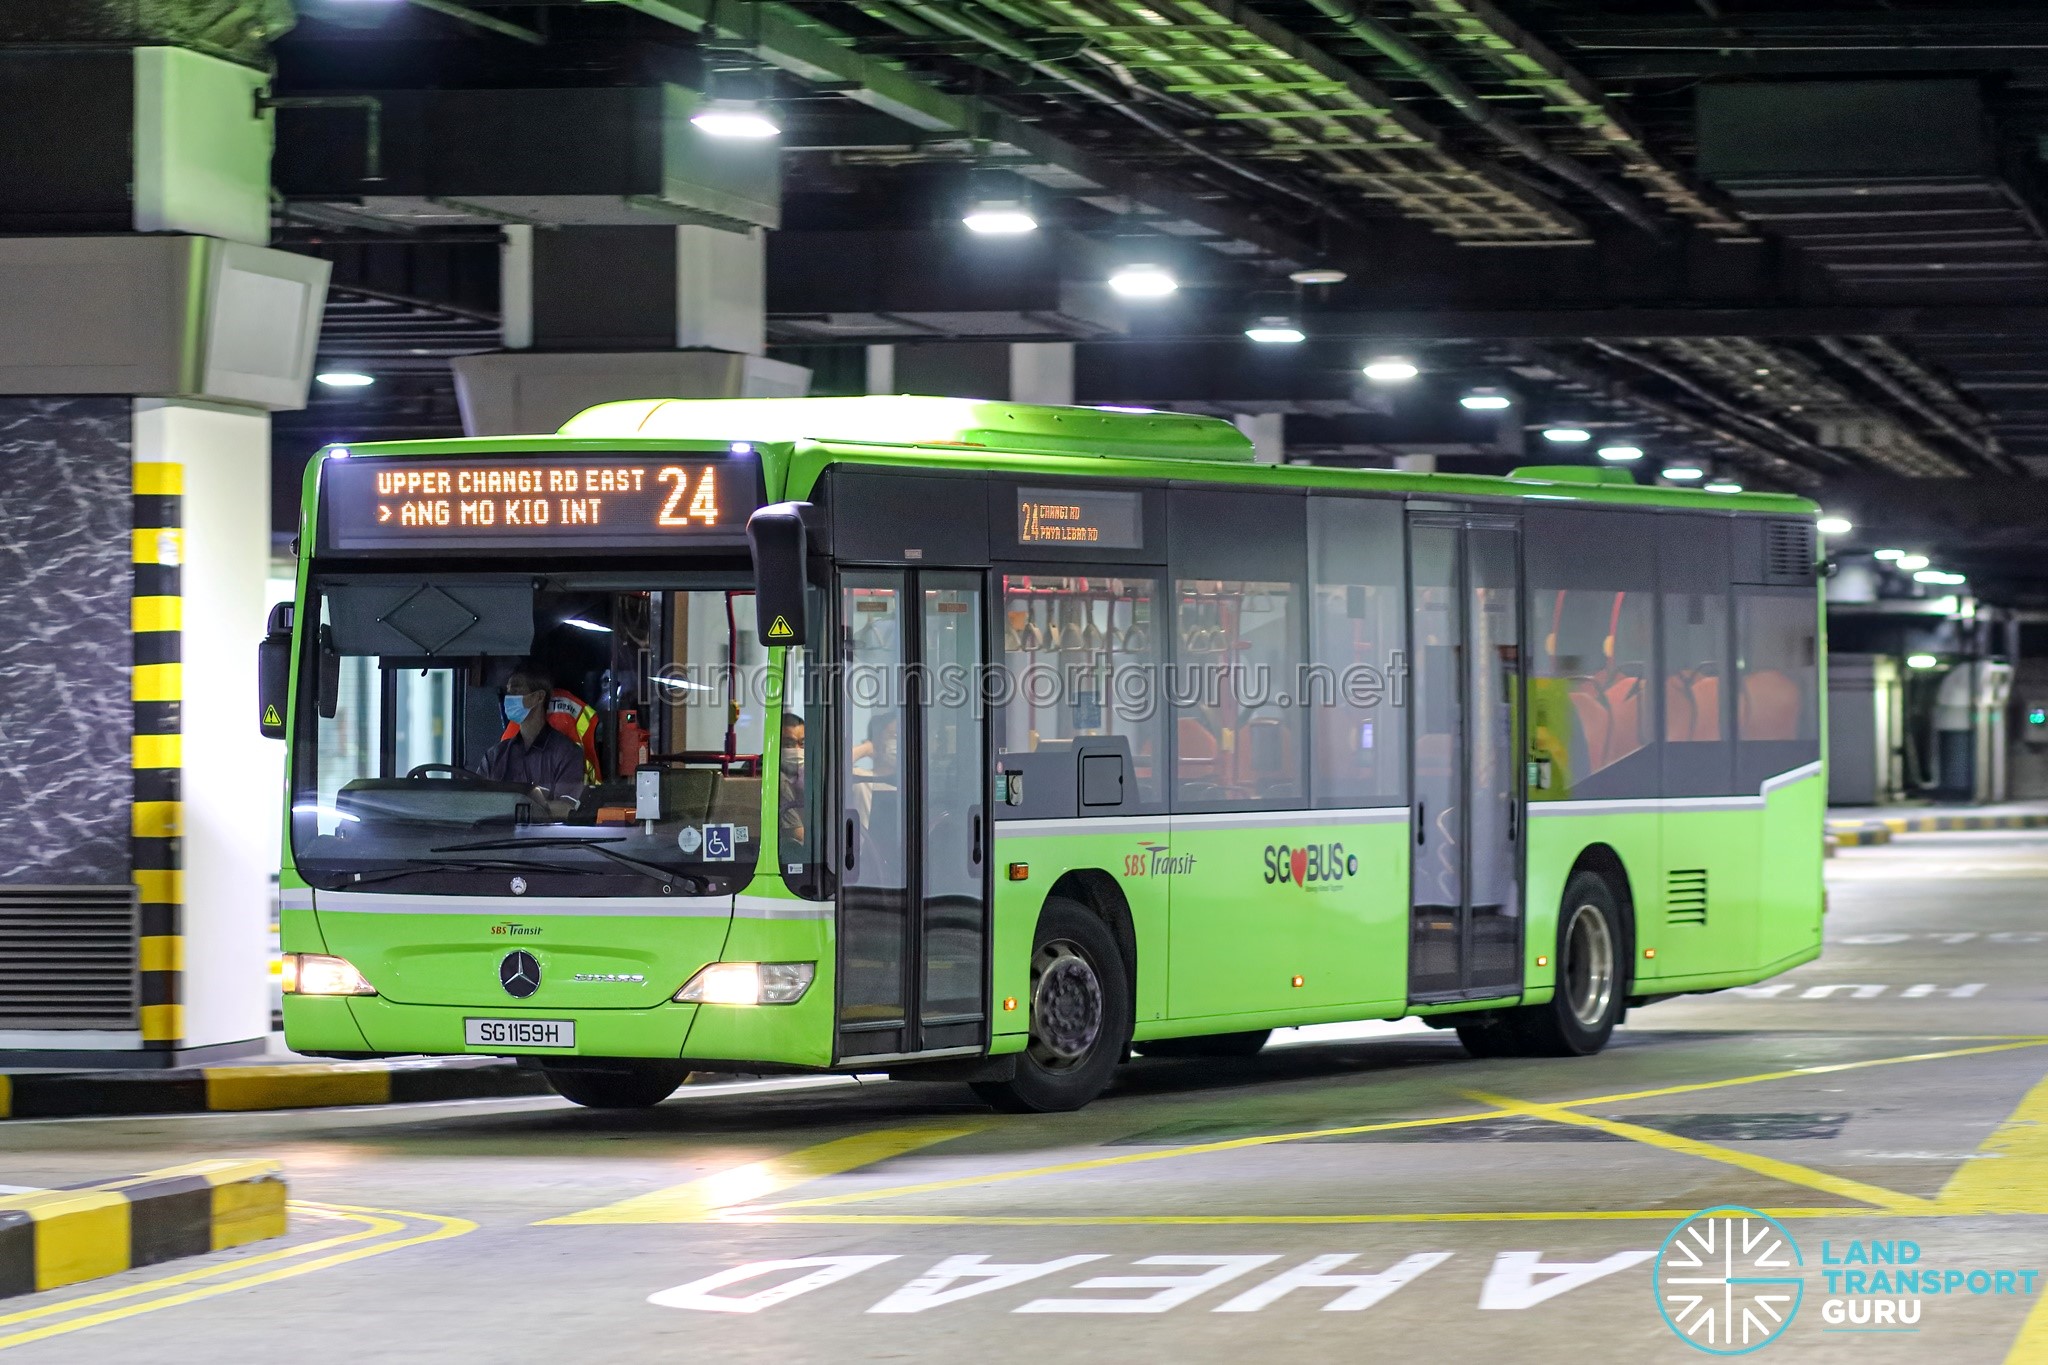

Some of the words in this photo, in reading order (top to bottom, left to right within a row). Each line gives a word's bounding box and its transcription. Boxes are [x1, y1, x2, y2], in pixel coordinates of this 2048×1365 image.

[377, 471, 451, 494] UPPER
[458, 470, 543, 493] CHANGI
[549, 470, 578, 492] RD
[586, 469, 644, 491] EAST
[658, 466, 718, 525] 24
[402, 501, 450, 526] ANG
[460, 500, 494, 525] MO
[506, 500, 549, 524] KIO
[560, 499, 601, 524] INT
[1022, 503, 1039, 540] 24
[1040, 505, 1068, 519] CHANGI
[1069, 506, 1080, 519] RD
[1040, 526, 1060, 540] PAYA
[1062, 527, 1087, 541] LEBAR
[1088, 528, 1098, 541] RD
[1123, 854, 1146, 877] SBS
[1145, 846, 1197, 879] Transit
[491, 926, 507, 935] SBS
[507, 924, 543, 936] Transit
[480, 1023, 559, 1043] SG1159H
